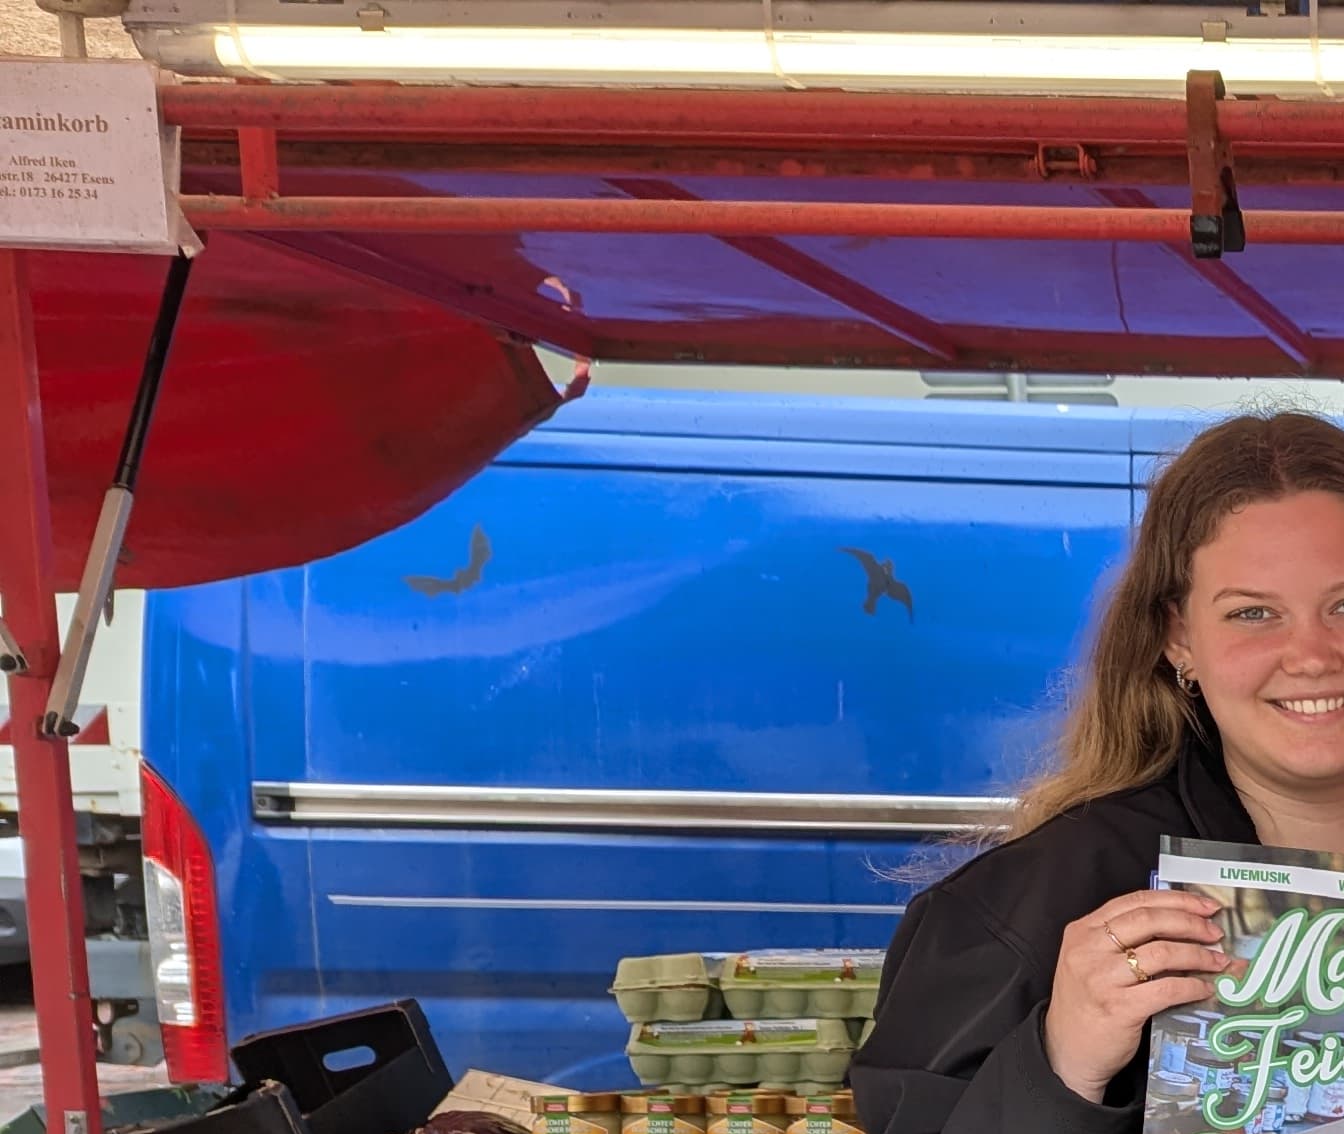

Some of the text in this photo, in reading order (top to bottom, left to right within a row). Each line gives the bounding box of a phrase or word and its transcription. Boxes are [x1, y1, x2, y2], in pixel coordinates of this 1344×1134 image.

[0, 112, 109, 133] aminkorb
[9, 155, 76, 168] Alfred Iken
[44, 172, 78, 184] 26427
[81, 173, 115, 185] Esens
[19, 187, 47, 198] 0173
[51, 188, 64, 199] 16
[68, 188, 82, 199] 25
[85, 188, 98, 200] 34
[1219, 867, 1290, 885] LIVEMUSIK
